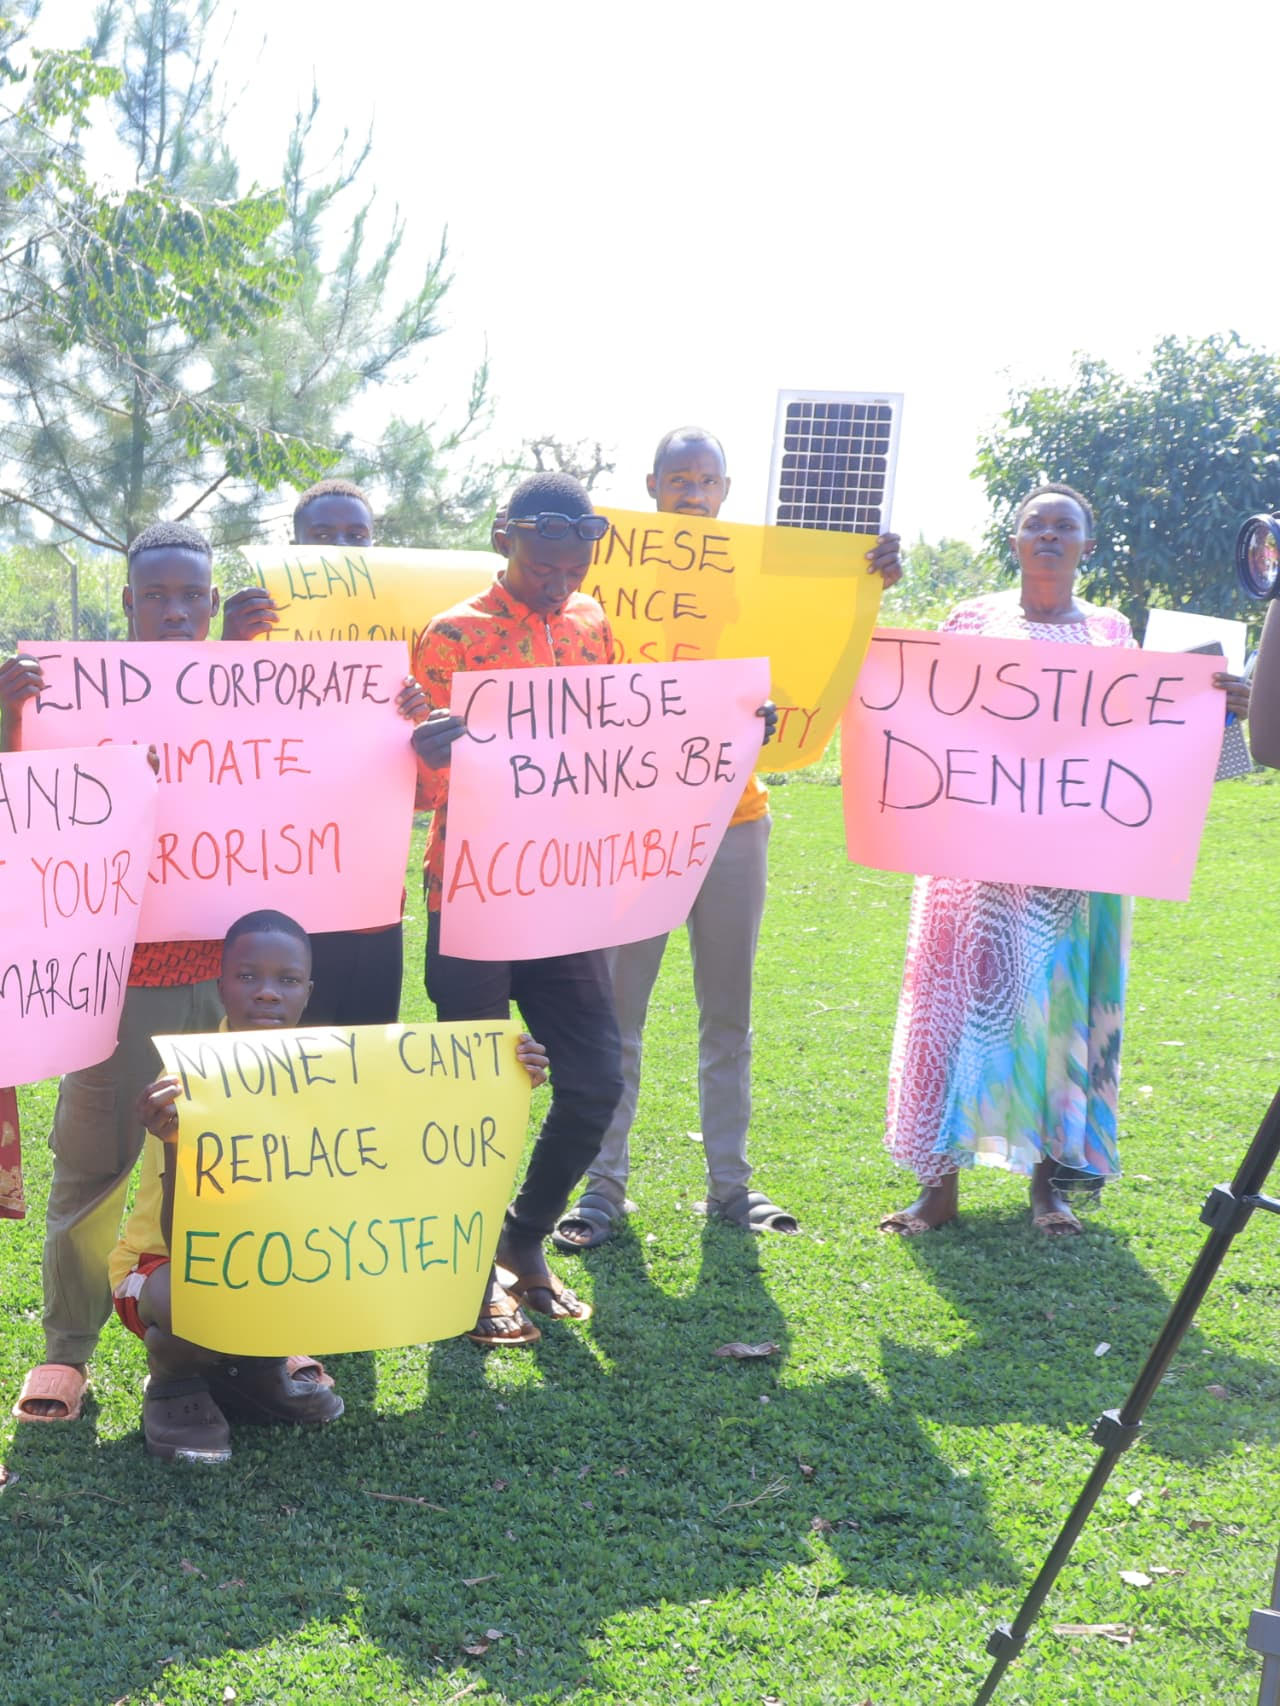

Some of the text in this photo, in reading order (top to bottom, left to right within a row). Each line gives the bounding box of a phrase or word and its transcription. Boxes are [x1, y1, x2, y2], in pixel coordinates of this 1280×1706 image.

[176, 659, 391, 710] CORPORATE
[464, 673, 687, 744] CHINESE
[860, 637, 1186, 727] JUSTICE
[509, 736, 736, 799] BANKS BE
[878, 729, 1153, 827] DENIED
[31, 850, 138, 929] YOUR
[446, 823, 712, 903] ACCOUNTABLE
[170, 1031, 505, 1101] MONEY CAN'T
[195, 1116, 506, 1197] REPLACE OUR
[184, 1211, 484, 1290] ECOSYSTEM
